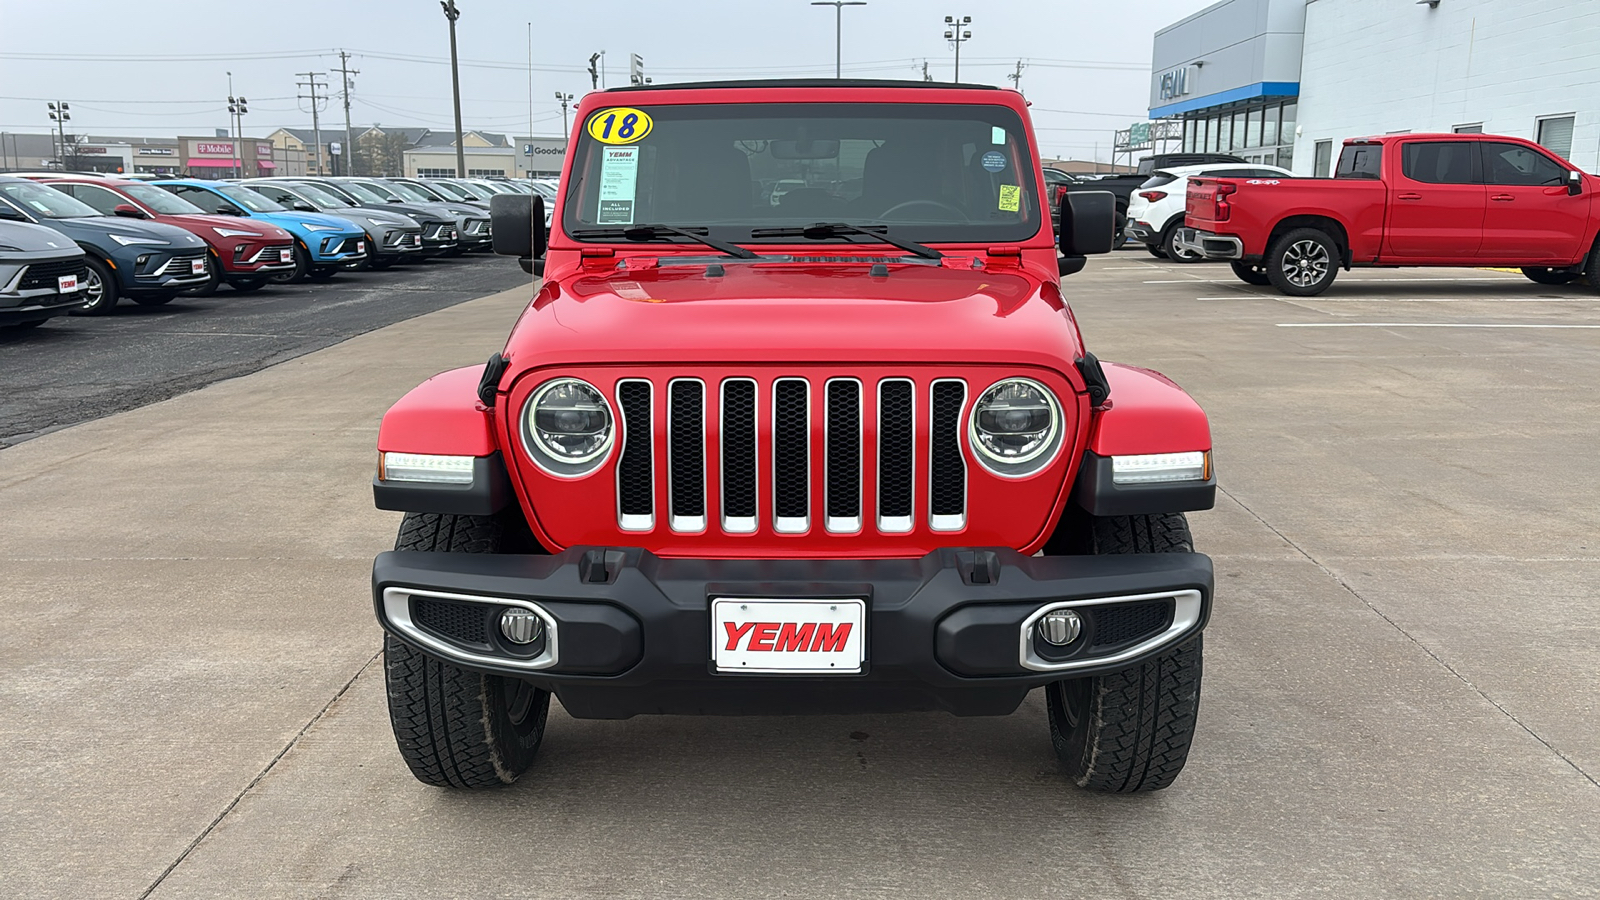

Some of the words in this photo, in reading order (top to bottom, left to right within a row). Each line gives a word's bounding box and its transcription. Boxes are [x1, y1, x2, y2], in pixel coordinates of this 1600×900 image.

[602, 112, 639, 139] 18
[60, 280, 76, 289] YEMM
[723, 621, 854, 652] YEMM
